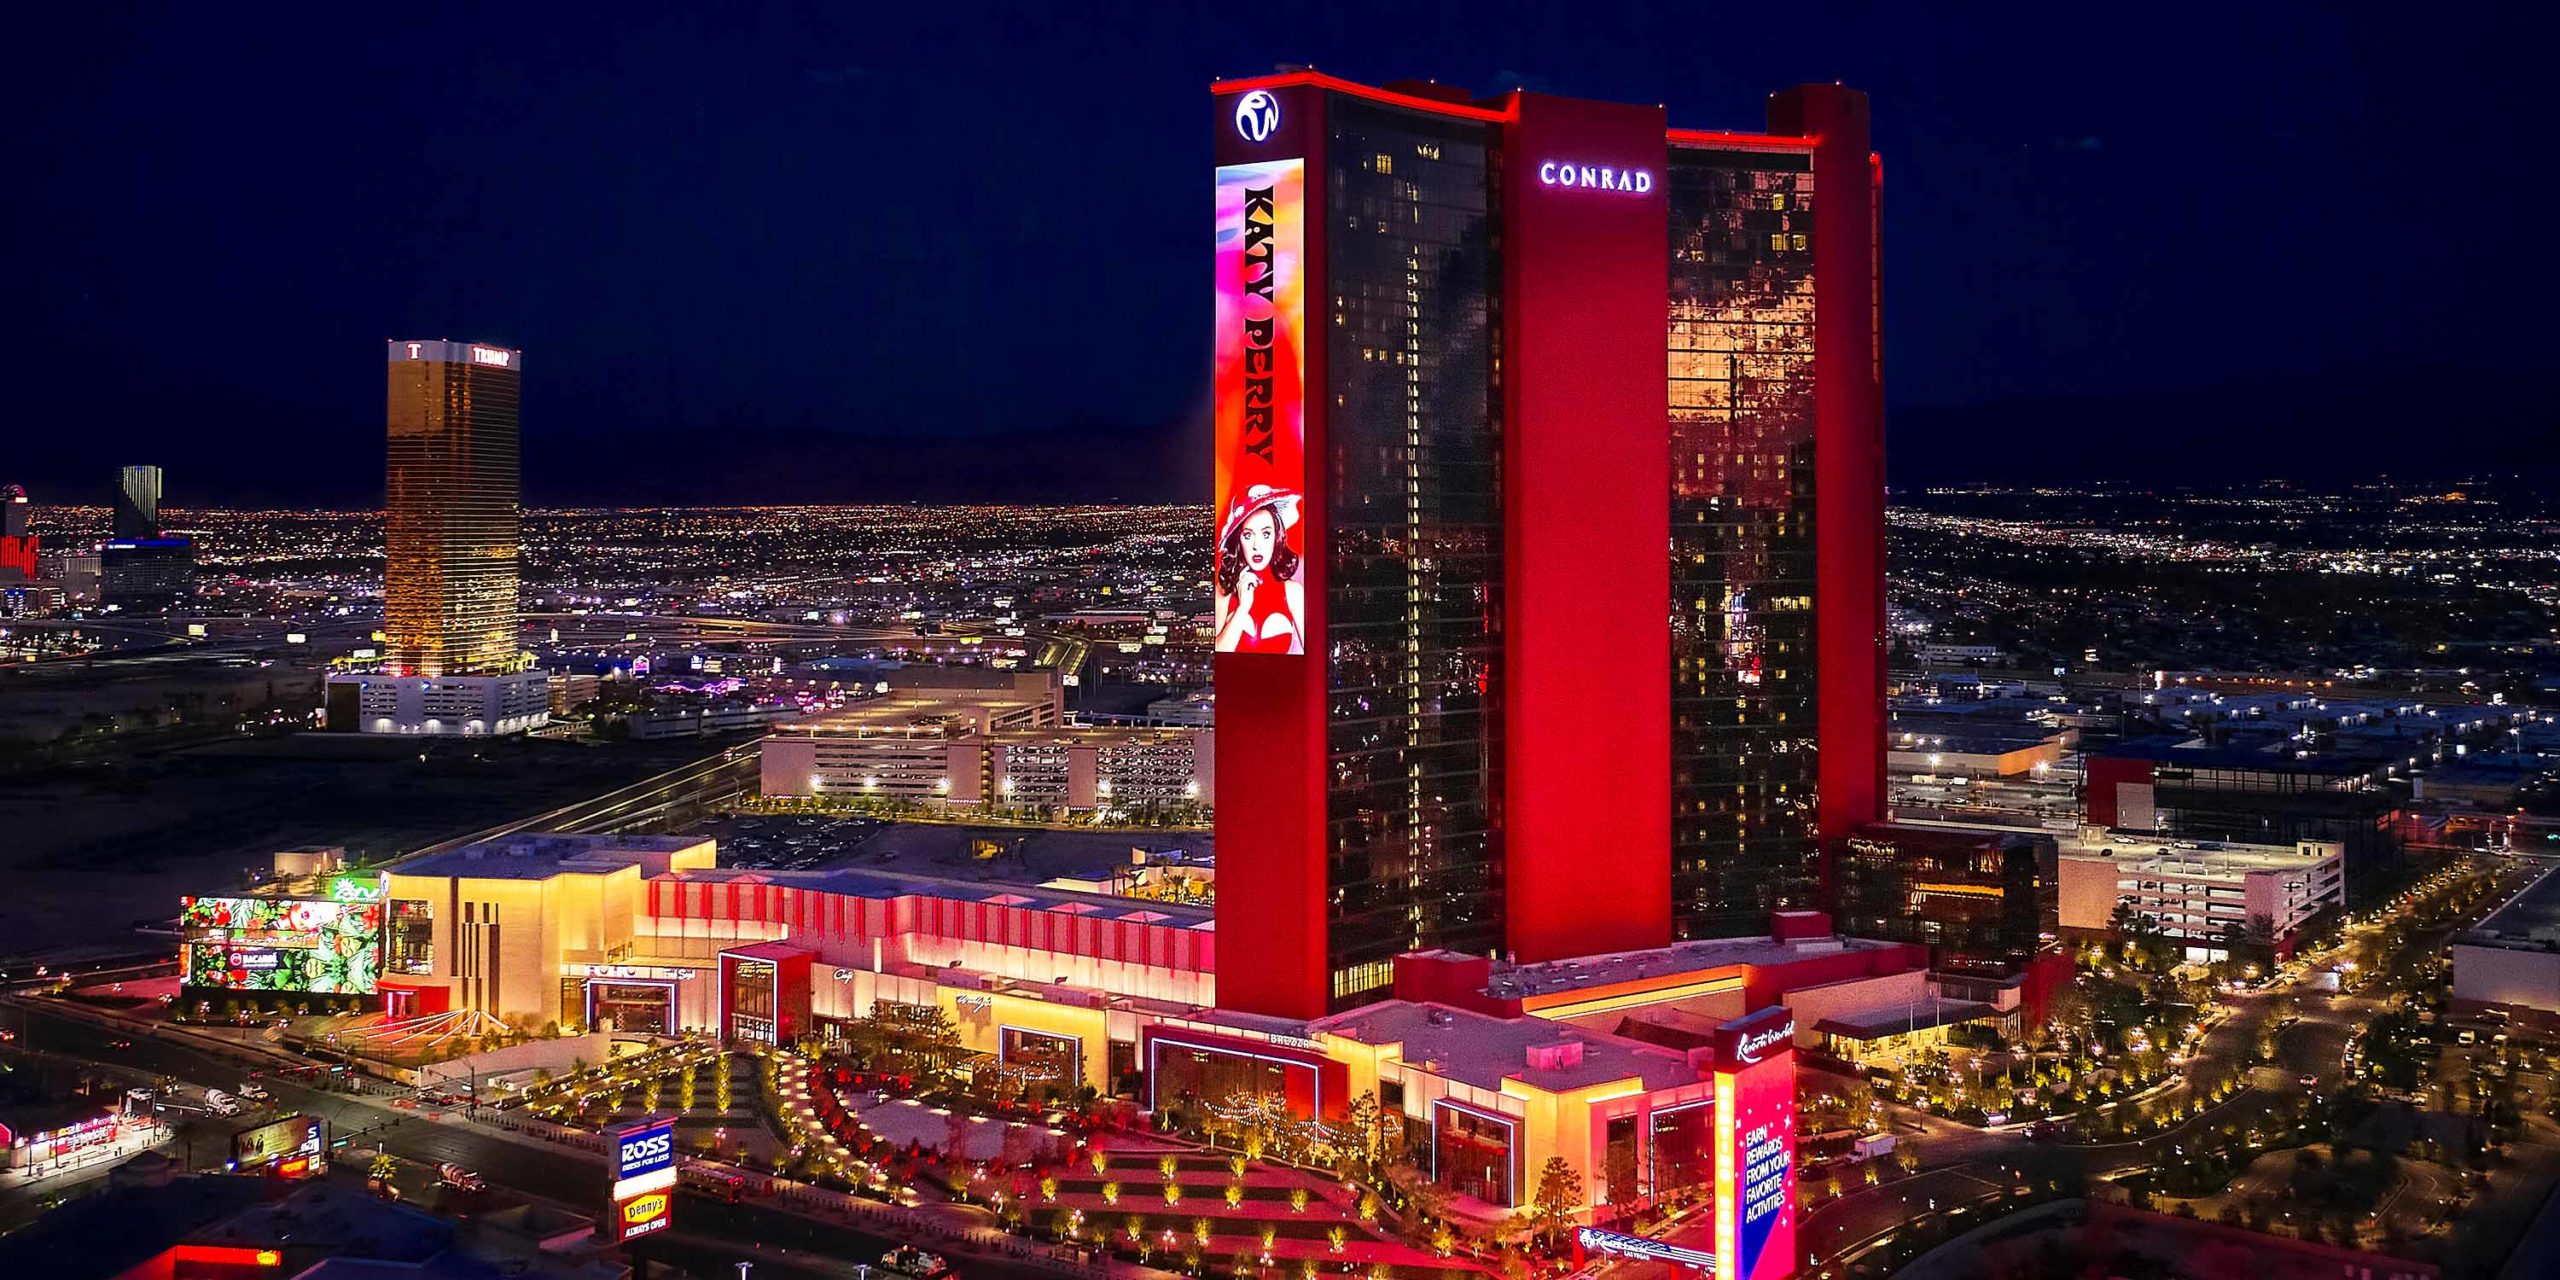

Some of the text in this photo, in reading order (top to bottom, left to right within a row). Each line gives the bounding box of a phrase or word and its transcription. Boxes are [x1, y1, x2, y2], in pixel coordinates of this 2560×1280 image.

[1540, 163, 1651, 193] CONRAD
[1244, 184, 1275, 466] KATY PERRY
[407, 343, 422, 359] T
[473, 346, 510, 367] TRUMP
[1270, 1033, 1309, 1049] BREZZA
[1737, 1020, 1795, 1063] Resorts World
[621, 1133, 670, 1162] ROSS
[1745, 1124, 1768, 1148] EARN
[642, 1158, 654, 1167] FOR
[1745, 1135, 1783, 1167] REWARDS
[1745, 1150, 1791, 1186] FROM YOUR
[1745, 1172, 1783, 1204] FAVORITE
[628, 1198, 663, 1219] Denny's
[1745, 1189, 1786, 1224] ACTIVITIES
[625, 1217, 667, 1238] ALWAYS OPEN
